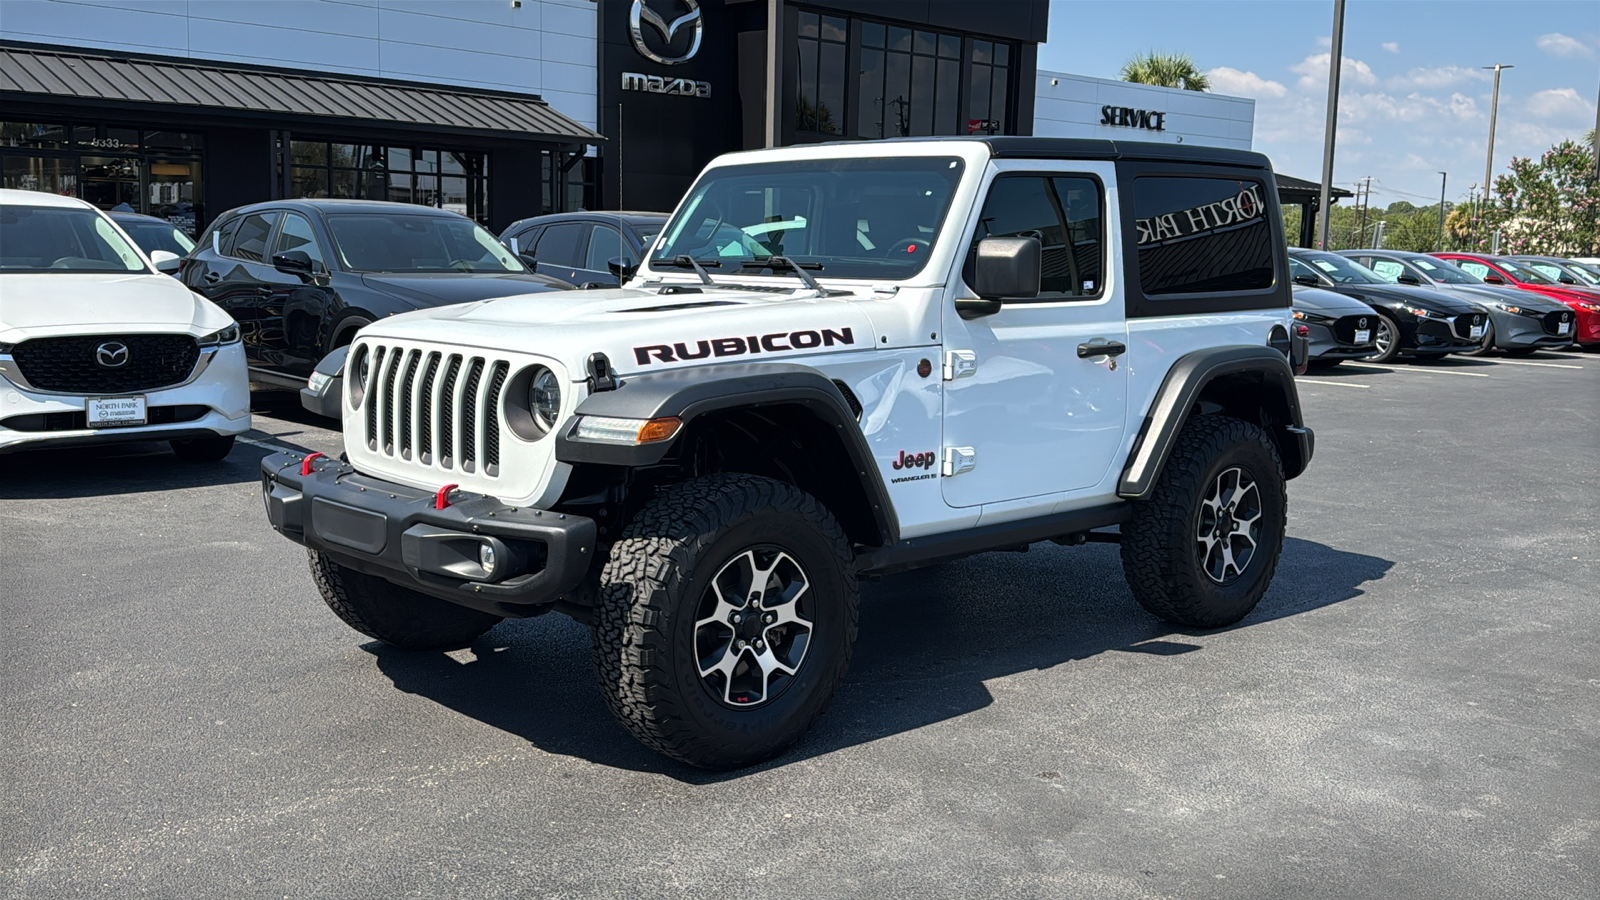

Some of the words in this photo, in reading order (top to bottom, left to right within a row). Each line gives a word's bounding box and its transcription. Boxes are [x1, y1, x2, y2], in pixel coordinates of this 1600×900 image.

[621, 71, 712, 98] mazda
[1100, 105, 1166, 131] SERVICE
[633, 327, 855, 366] RUBICON
[892, 449, 936, 471] Jeep
[891, 474, 930, 484] WRANGLER
